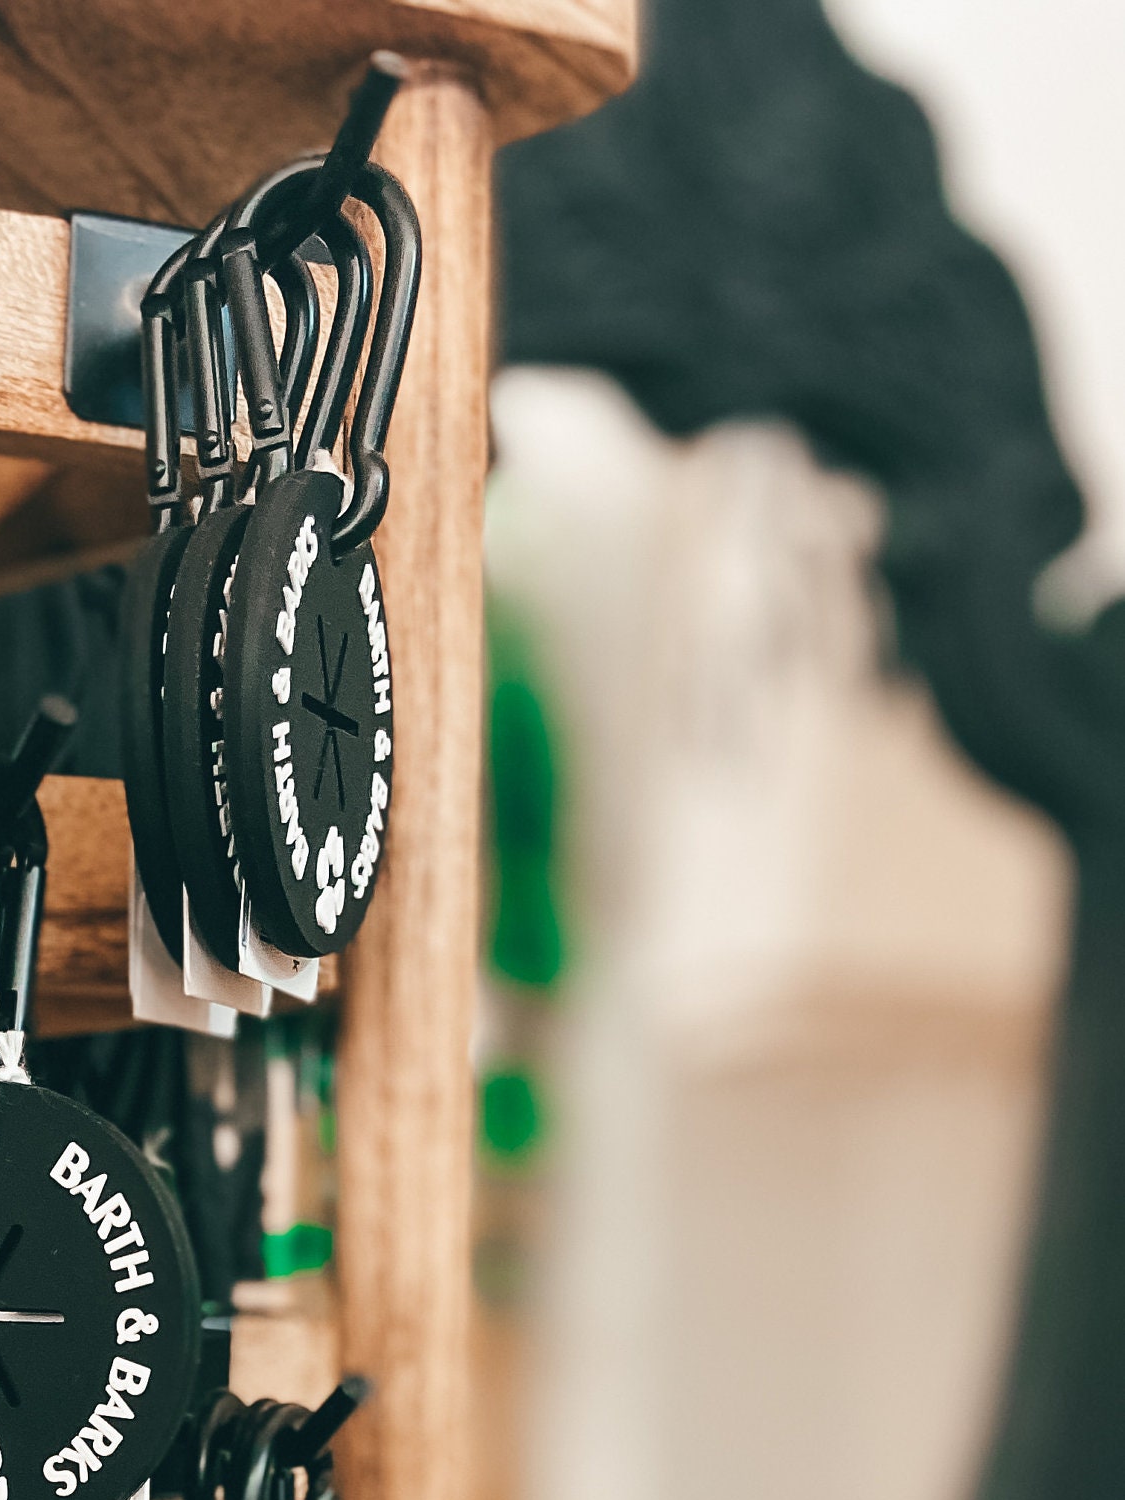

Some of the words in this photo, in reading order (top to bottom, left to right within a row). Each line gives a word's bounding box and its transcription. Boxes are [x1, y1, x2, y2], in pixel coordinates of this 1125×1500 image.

[50, 1142, 153, 1292] BARTH
[117, 1308, 159, 1344] &
[43, 1357, 151, 1496] BARKS
